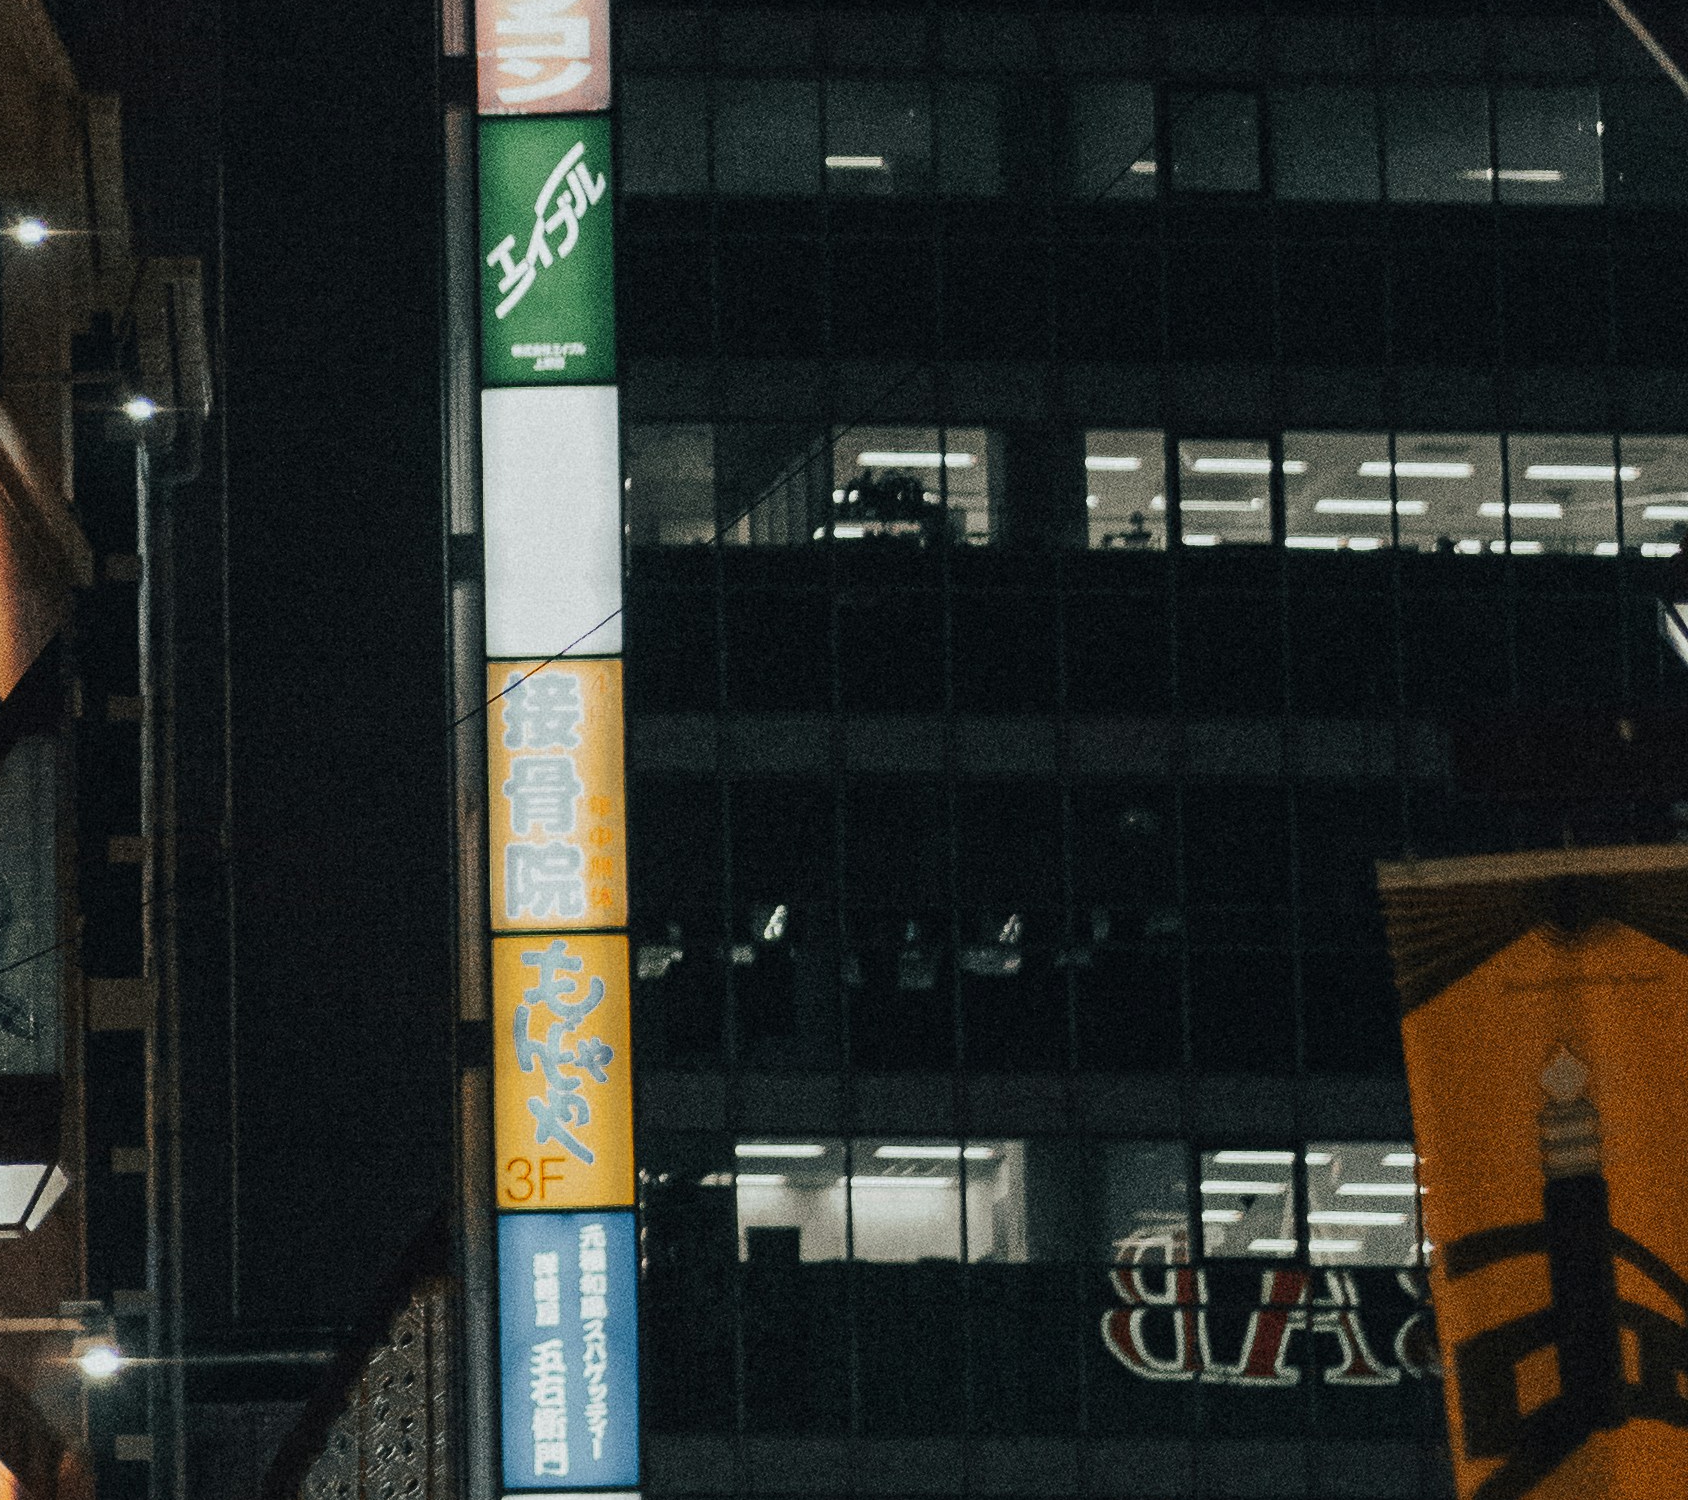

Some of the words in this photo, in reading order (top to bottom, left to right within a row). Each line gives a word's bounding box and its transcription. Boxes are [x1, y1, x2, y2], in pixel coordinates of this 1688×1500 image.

[485, 140, 607, 320] エイブル
[500, 670, 587, 921] 接骨院
[505, 1156, 567, 1203] 3F
[530, 1339, 569, 1477] 五右衛門
